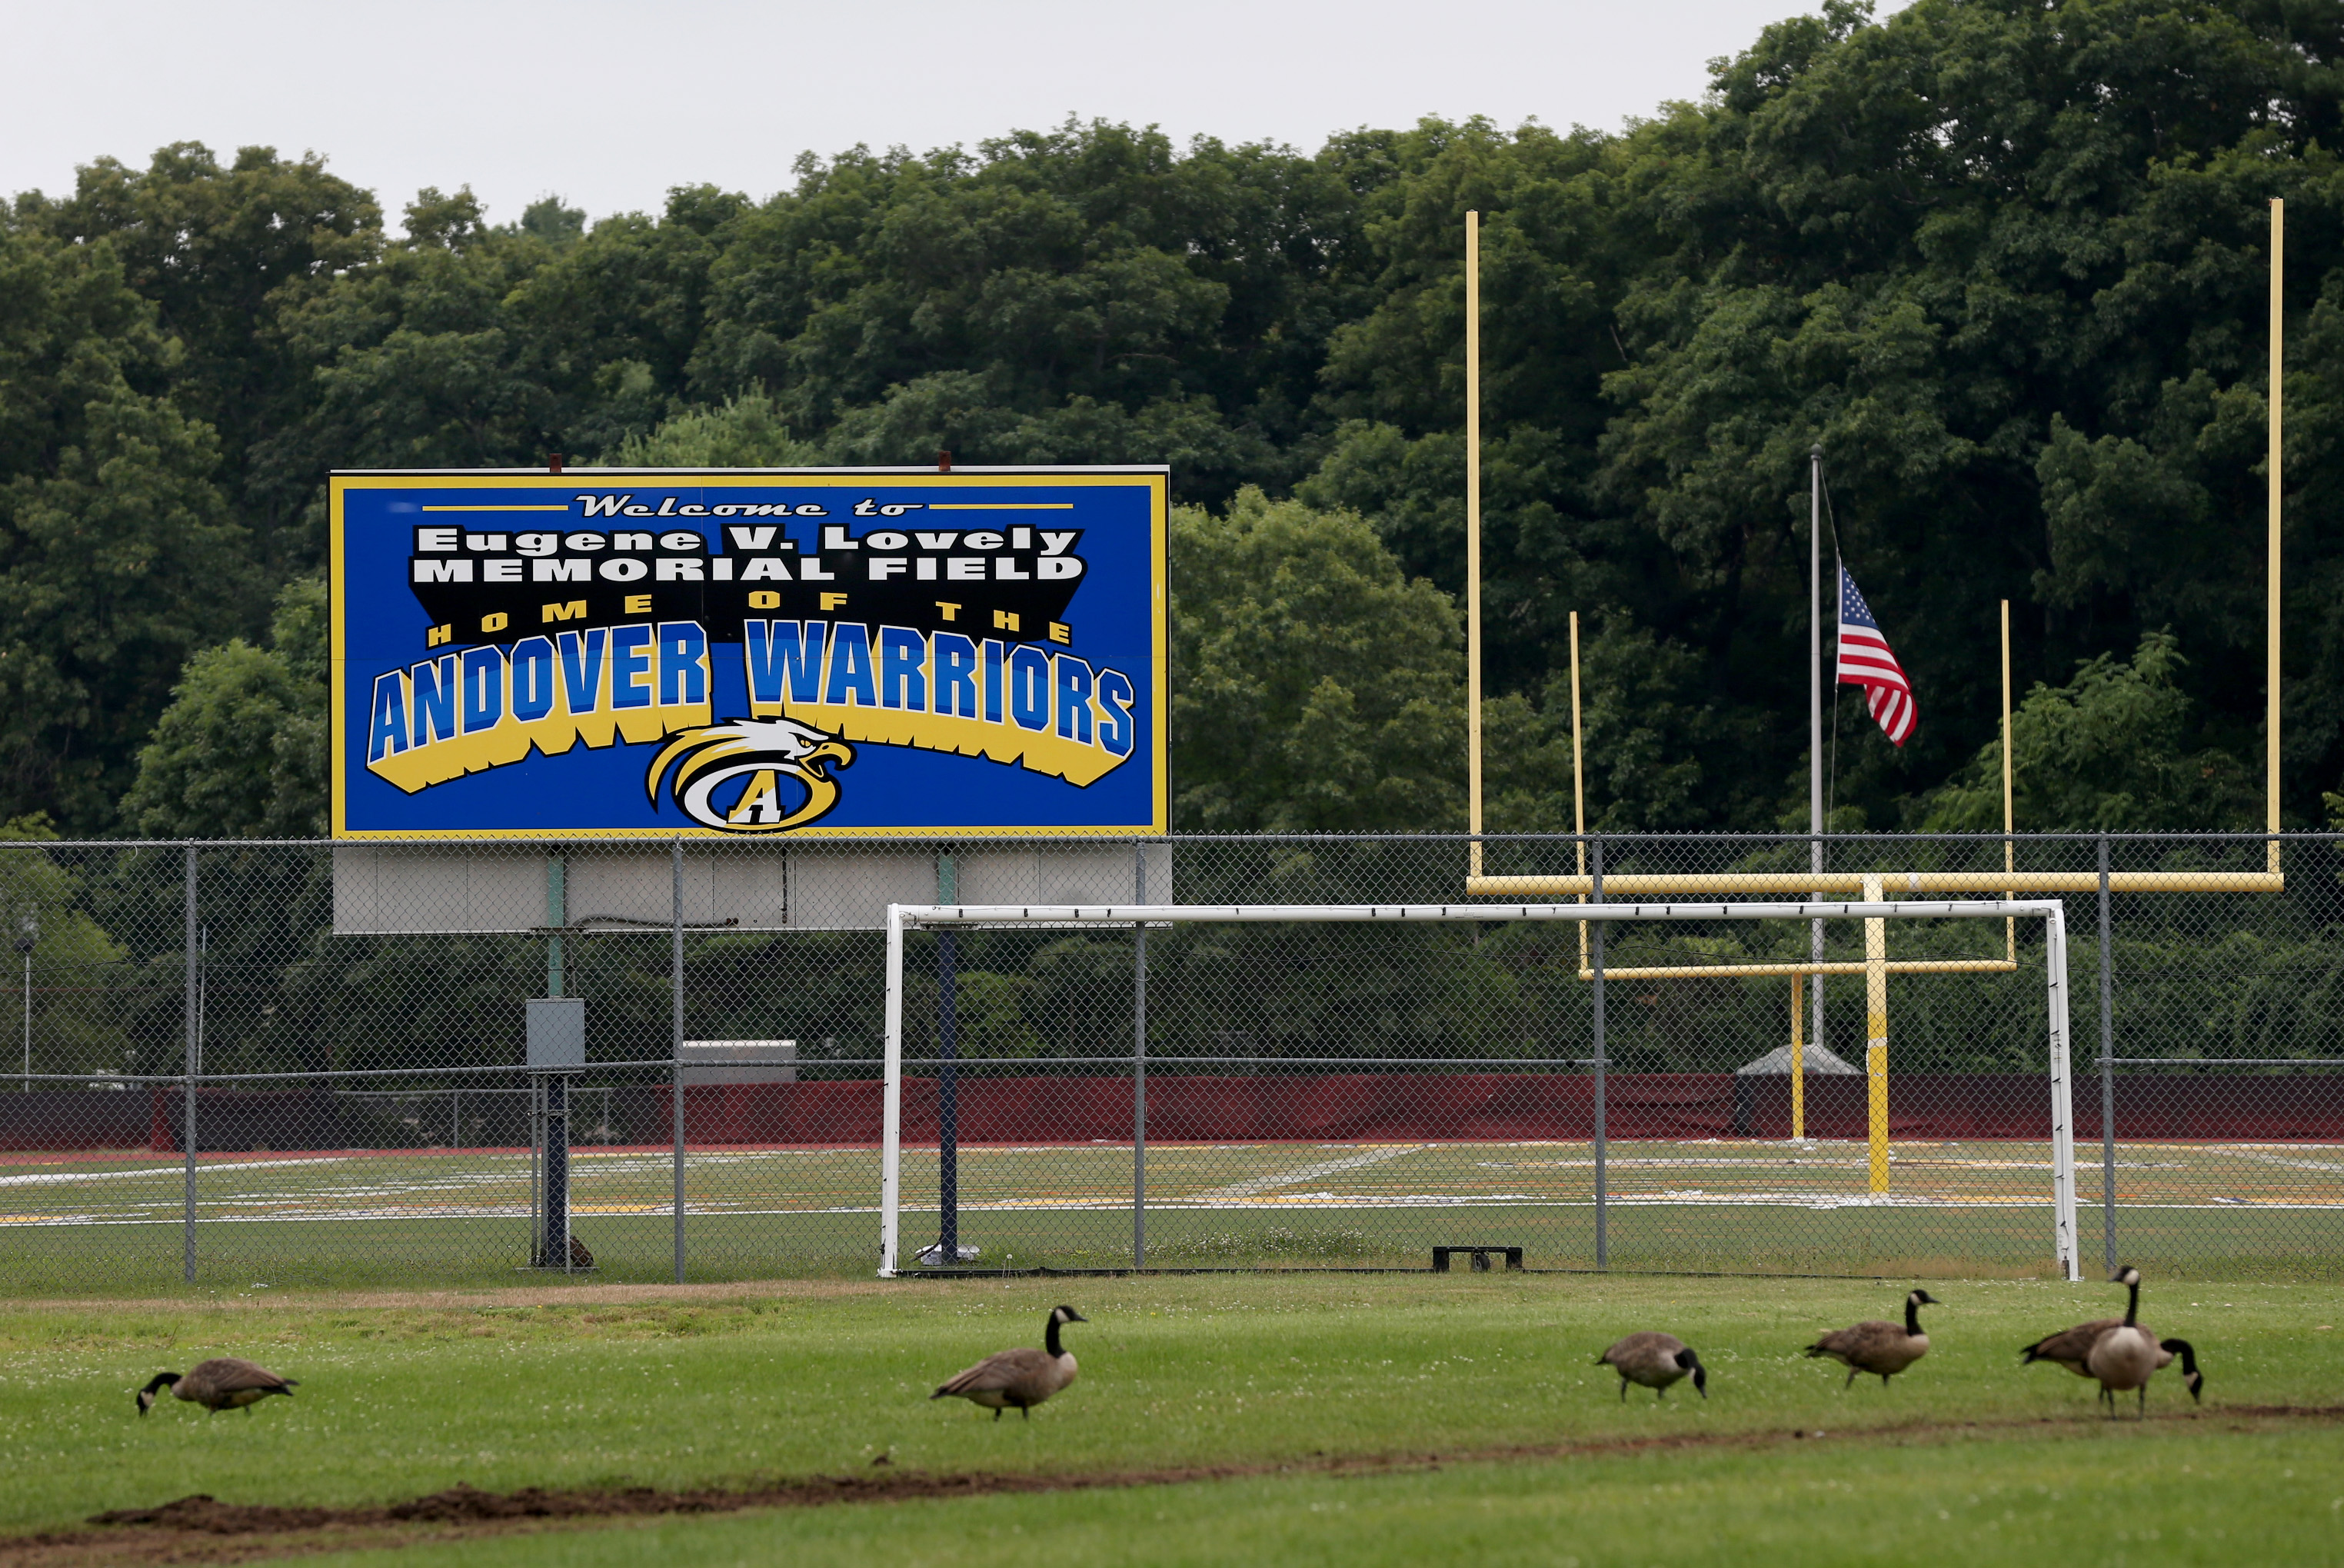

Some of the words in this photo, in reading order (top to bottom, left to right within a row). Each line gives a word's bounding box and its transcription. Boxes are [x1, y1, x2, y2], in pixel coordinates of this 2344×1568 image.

[574, 494, 828, 518] Welcome
[854, 498, 924, 517] to
[418, 528, 701, 557] Eugene
[728, 527, 794, 551] V.
[824, 527, 1077, 556] Lovely
[413, 558, 835, 583] MEMORIAL
[868, 557, 1083, 581] FIELD
[428, 594, 653, 648] HOME
[747, 591, 848, 611] OF
[935, 601, 1070, 644] THE
[367, 620, 708, 767] ANDOVER
[744, 619, 1134, 759] WARRIORS
